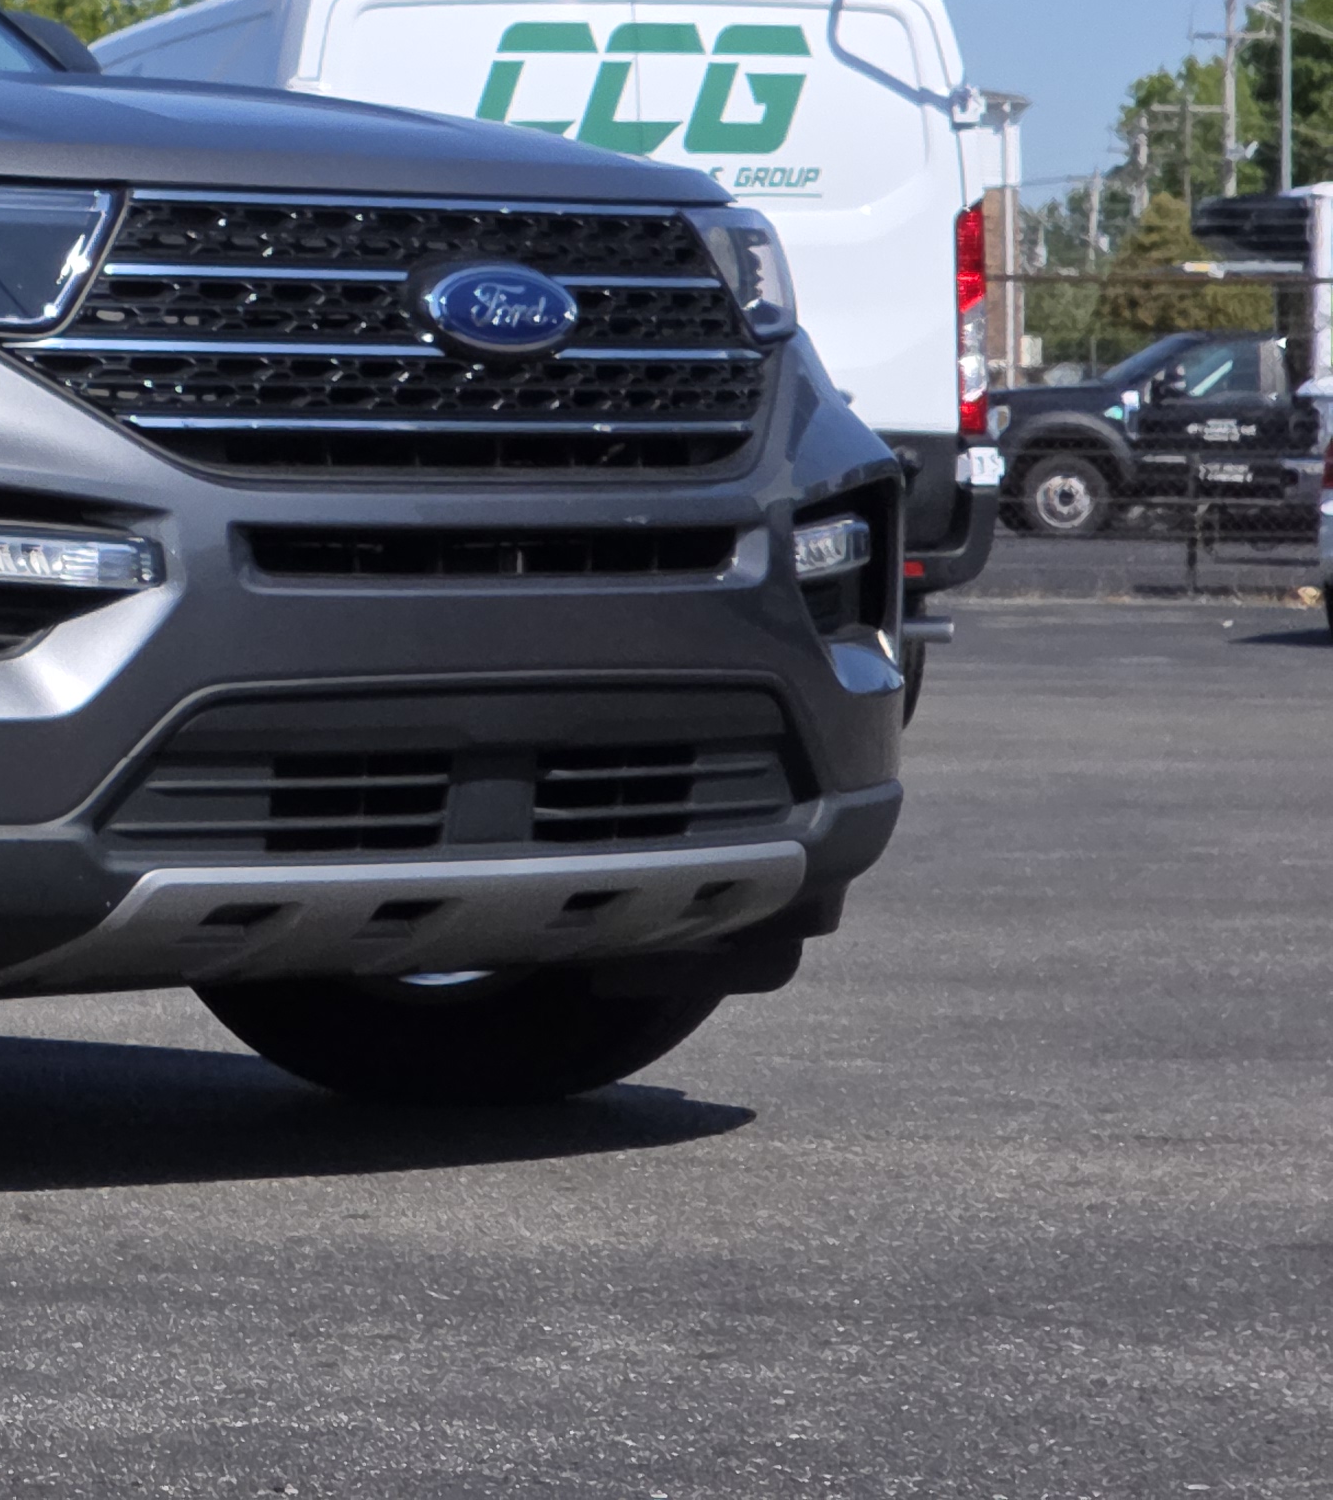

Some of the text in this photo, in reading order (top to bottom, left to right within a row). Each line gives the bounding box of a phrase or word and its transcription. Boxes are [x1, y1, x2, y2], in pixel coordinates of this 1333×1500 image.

[475, 21, 812, 156] CCG
[733, 166, 821, 188] GROUP
[470, 282, 549, 328] Ford
